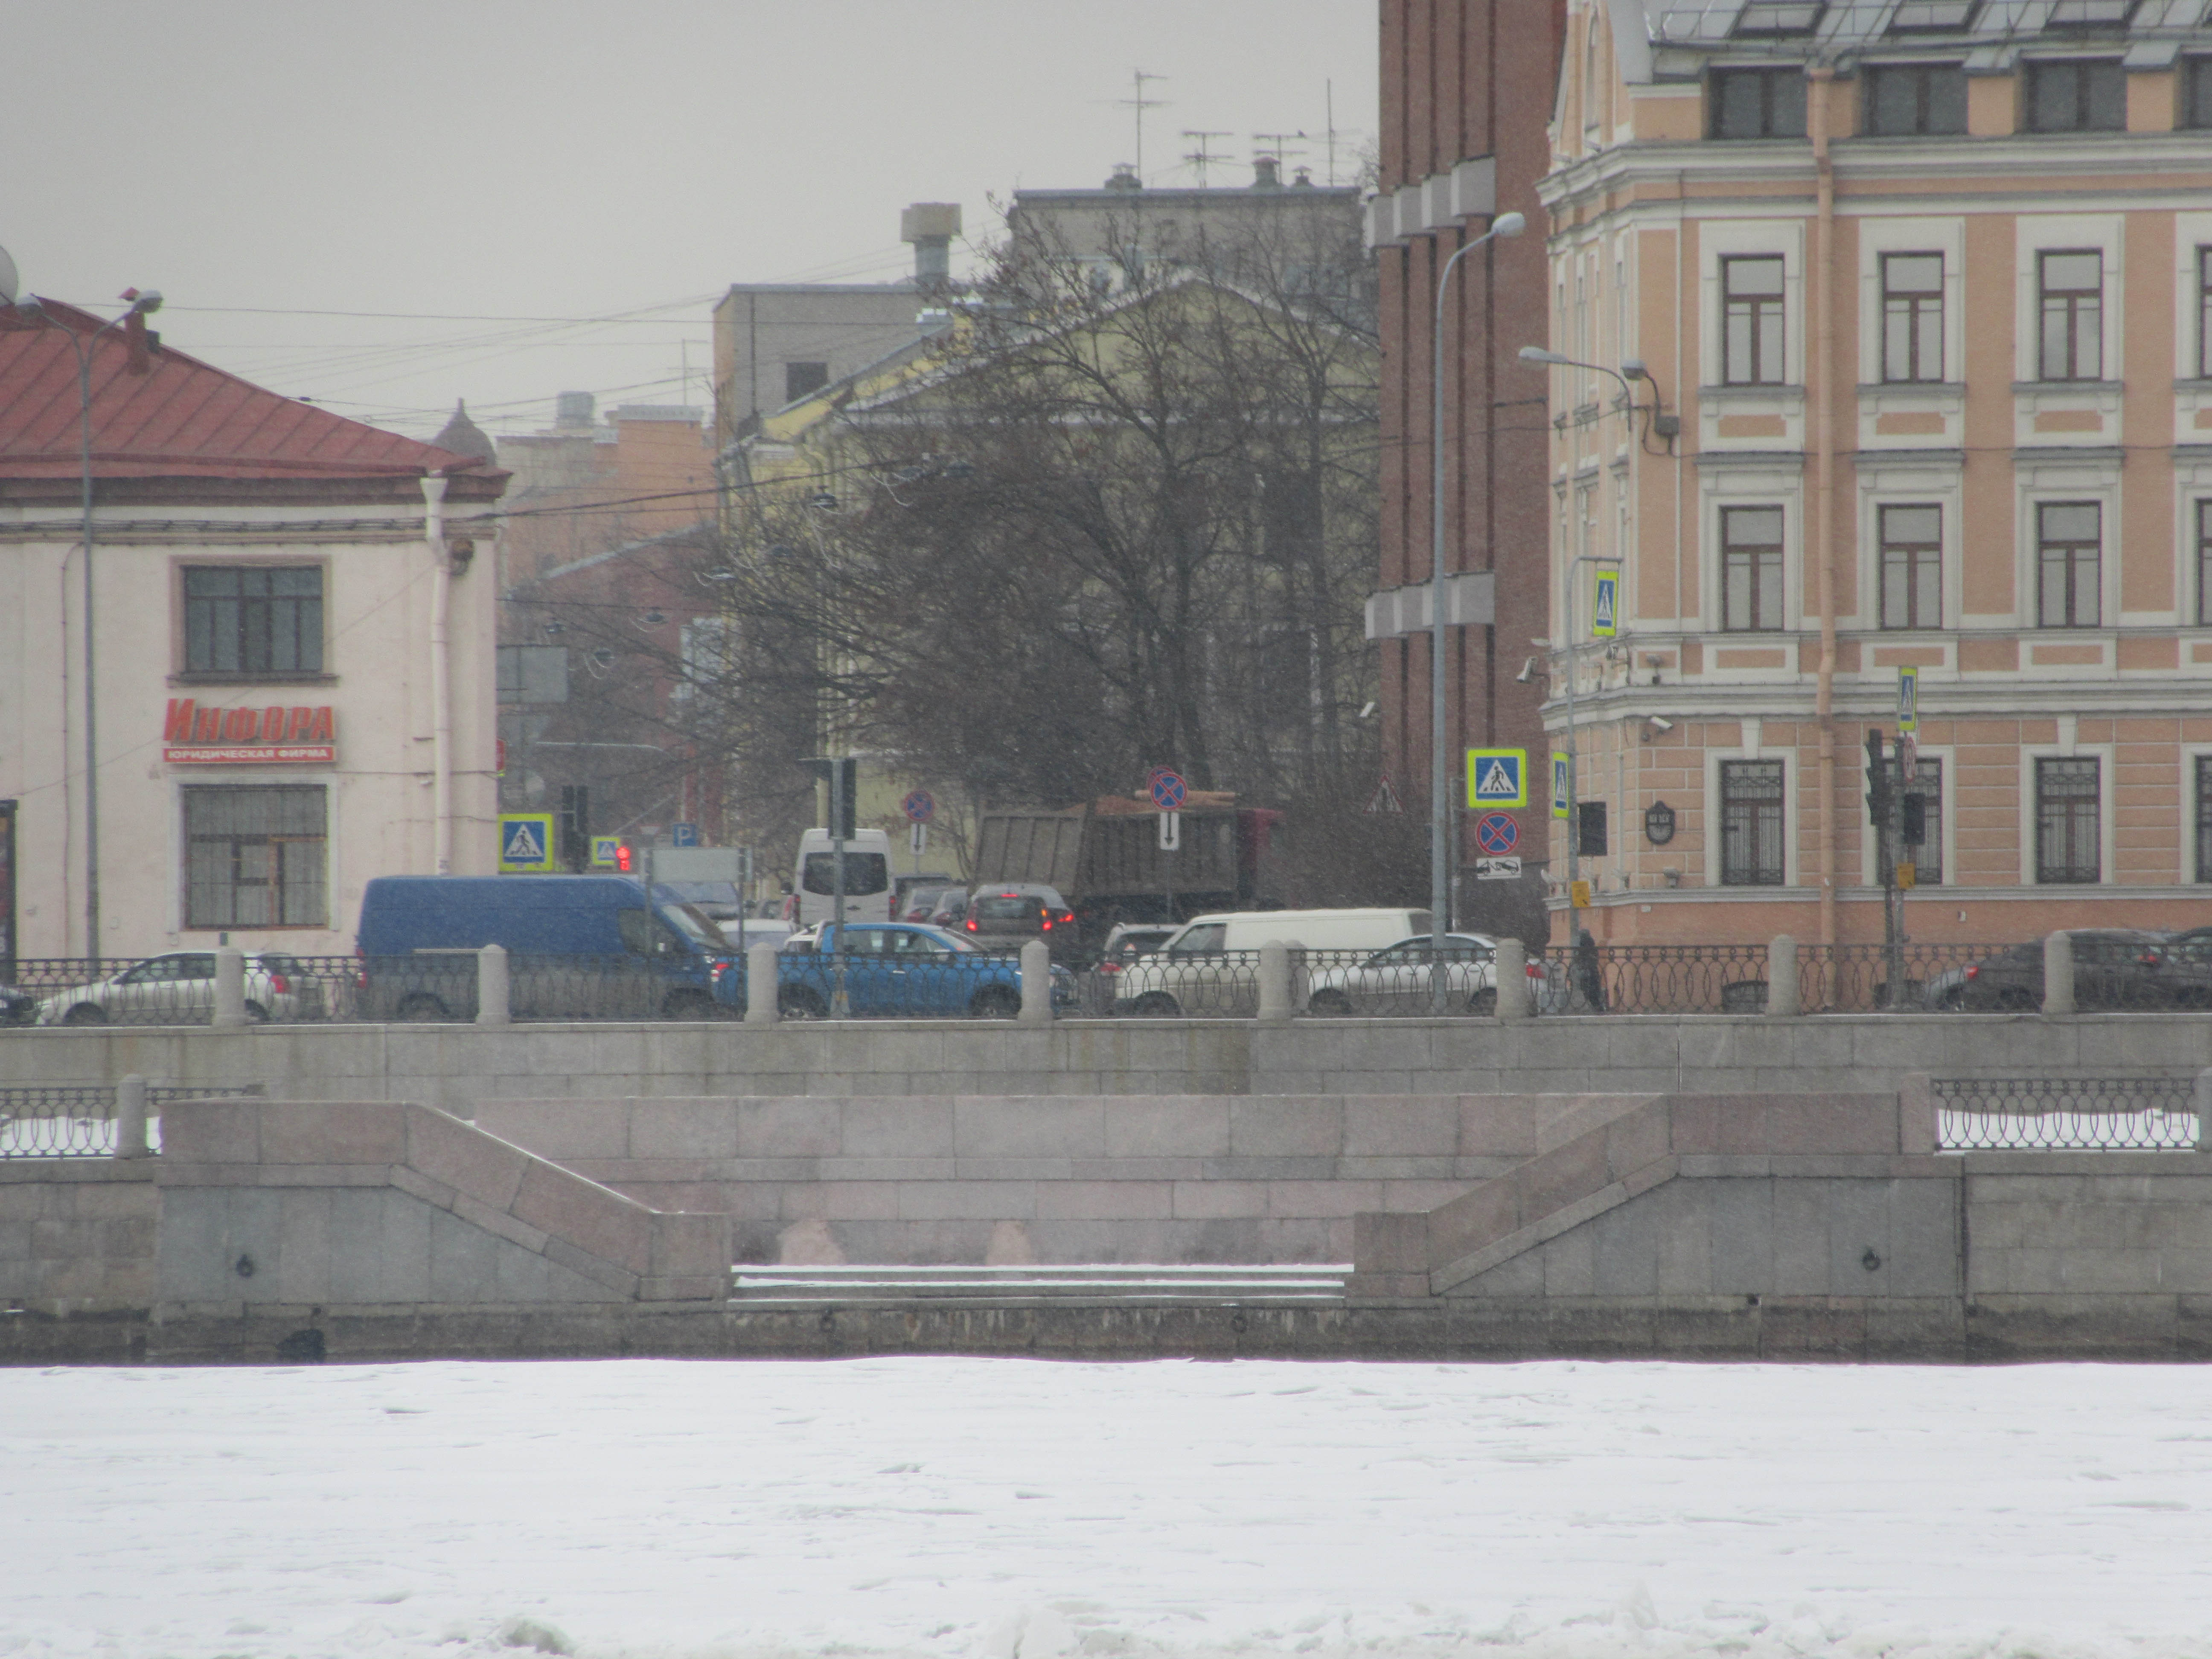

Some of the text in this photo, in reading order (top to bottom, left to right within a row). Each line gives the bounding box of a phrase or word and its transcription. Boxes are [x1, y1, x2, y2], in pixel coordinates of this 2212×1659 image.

[168, 749, 328, 759] ЮРИДИЧЕСКАЯ ФИРМА
[678, 826, 690, 847] P
